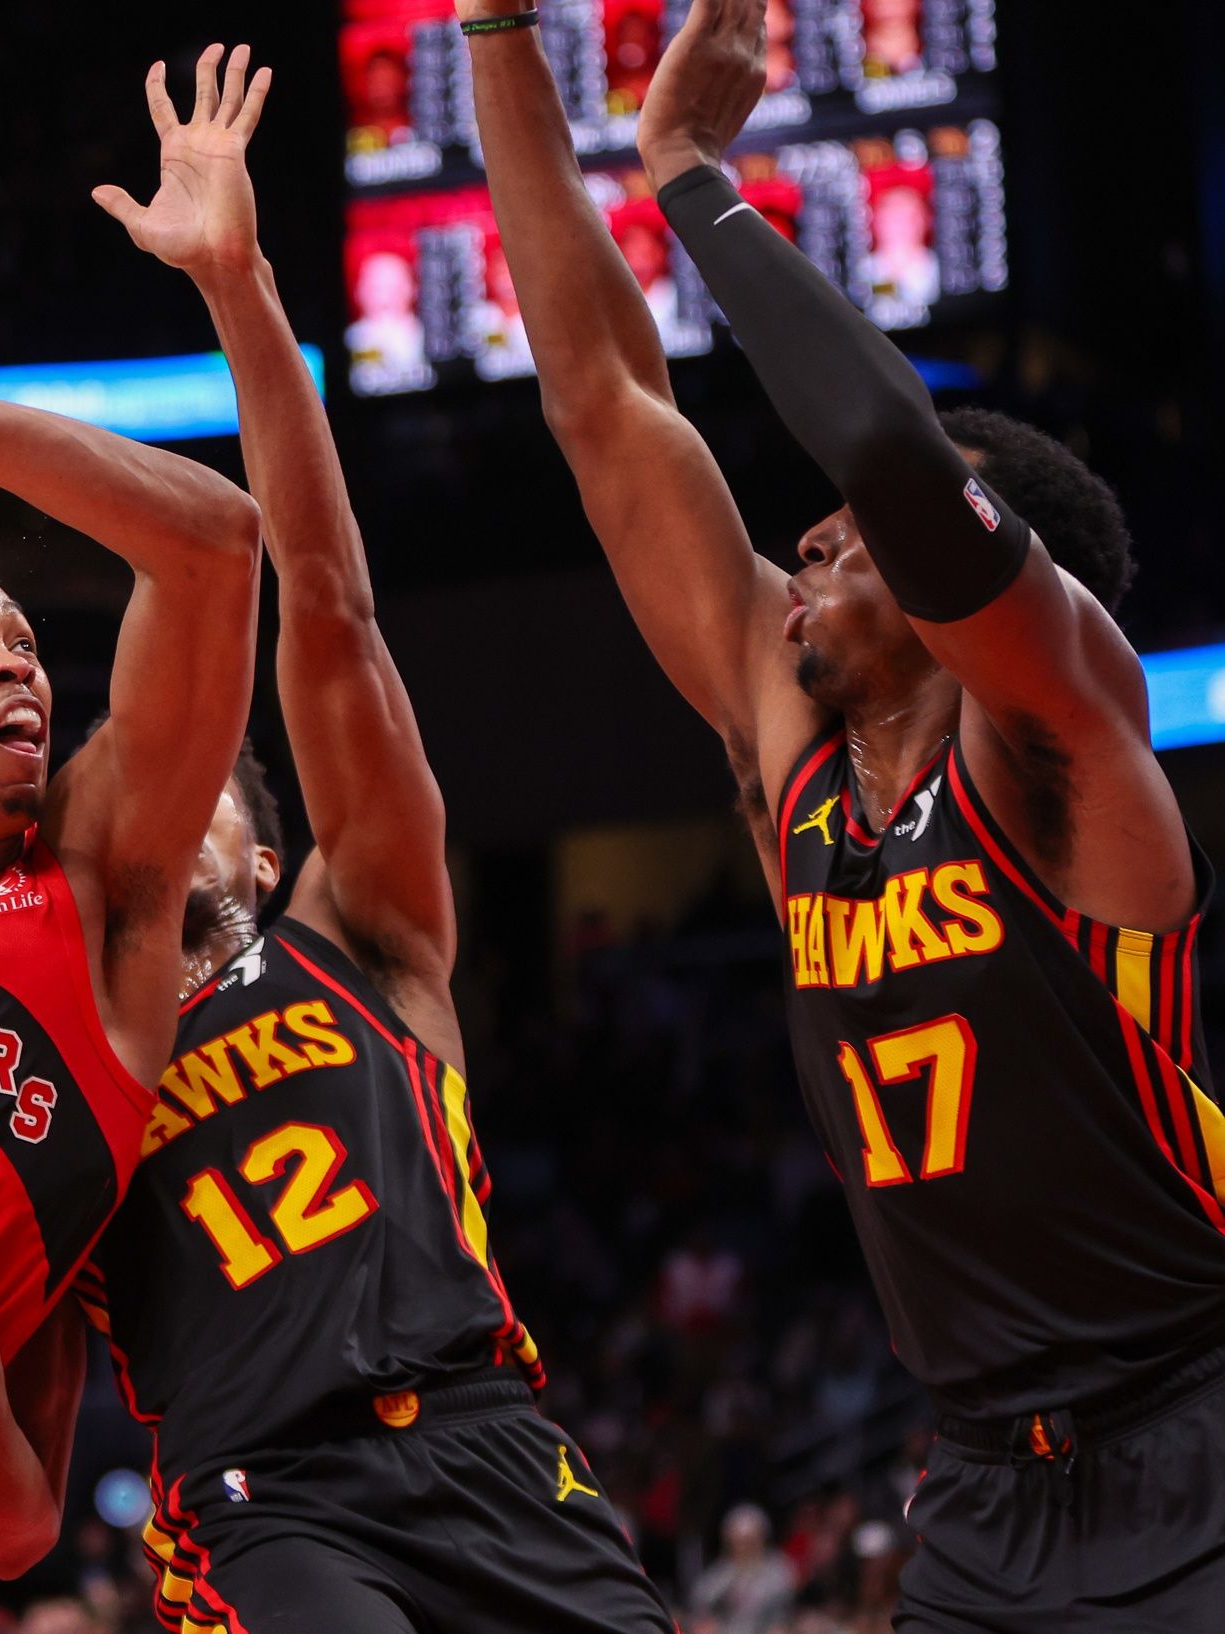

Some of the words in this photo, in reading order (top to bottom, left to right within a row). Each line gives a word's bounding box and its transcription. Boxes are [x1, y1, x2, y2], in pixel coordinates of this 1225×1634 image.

[10, 891, 44, 910] Life
[894, 820, 916, 836] the
[788, 859, 1005, 989] HAWKS
[139, 999, 357, 1161] AWKS
[837, 1013, 979, 1189] 17
[179, 1120, 380, 1291] 12
